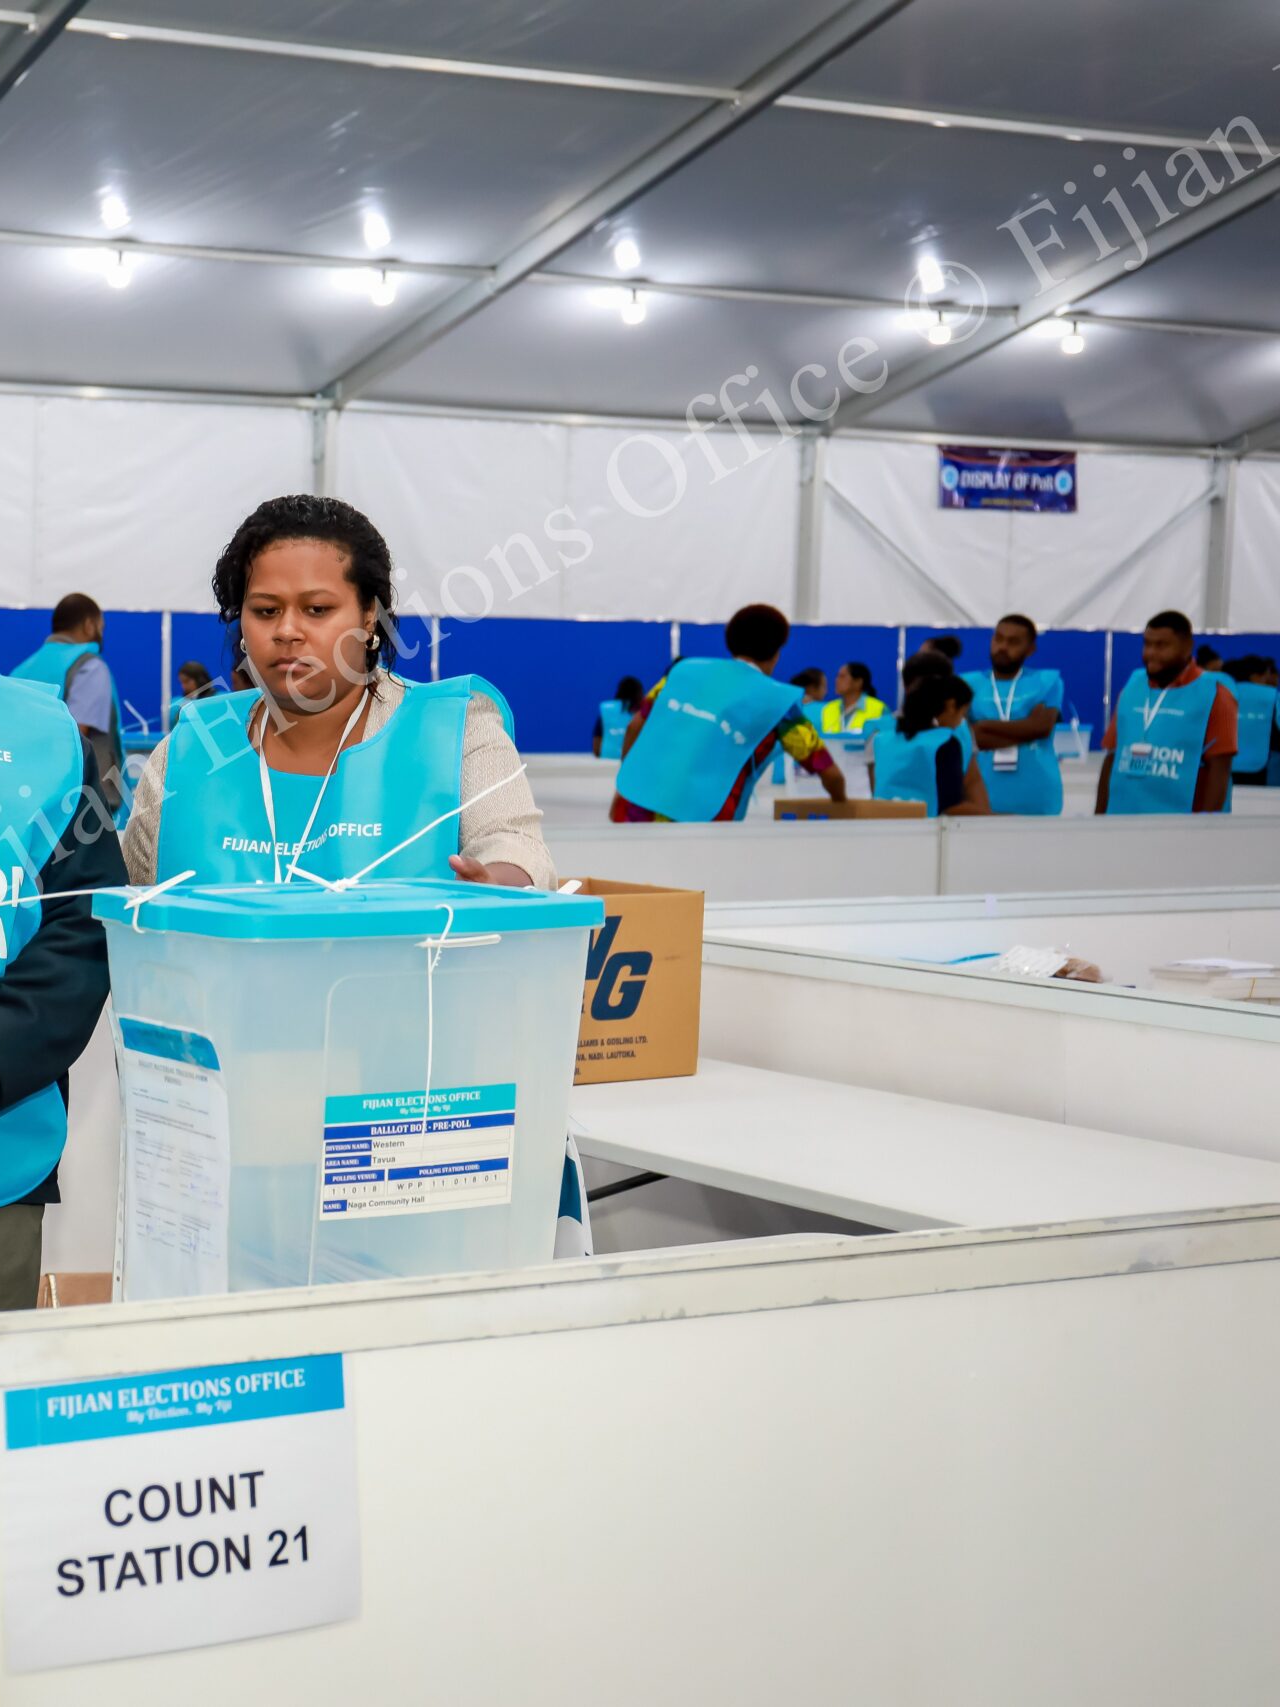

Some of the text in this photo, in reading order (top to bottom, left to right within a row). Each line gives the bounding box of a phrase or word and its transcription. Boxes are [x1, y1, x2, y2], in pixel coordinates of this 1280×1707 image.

[959, 469, 1011, 490] DISPLAY
[1012, 471, 1030, 490] OF
[222, 836, 271, 854] FIJIAN
[328, 822, 382, 838] OFFICE
[607, 1036, 634, 1046] GOSLING
[363, 1099, 393, 1110] FIJIAN
[448, 1090, 481, 1102] OFFICE
[433, 1119, 472, 1131] PRE-POLL
[372, 1140, 404, 1149] Western
[325, 1159, 341, 1167] AREA
[372, 1156, 396, 1165] Tavua
[419, 1166, 442, 1175] POLLING
[442, 1164, 464, 1173] STATION
[332, 1174, 357, 1182] POLLING
[348, 1195, 425, 1210] Naga Community Hall
[47, 1367, 306, 1420] FIJIAN ELECTIONS OFFICE
[104, 1470, 265, 1527] COUNT
[56, 1525, 309, 1598] STATION 21
